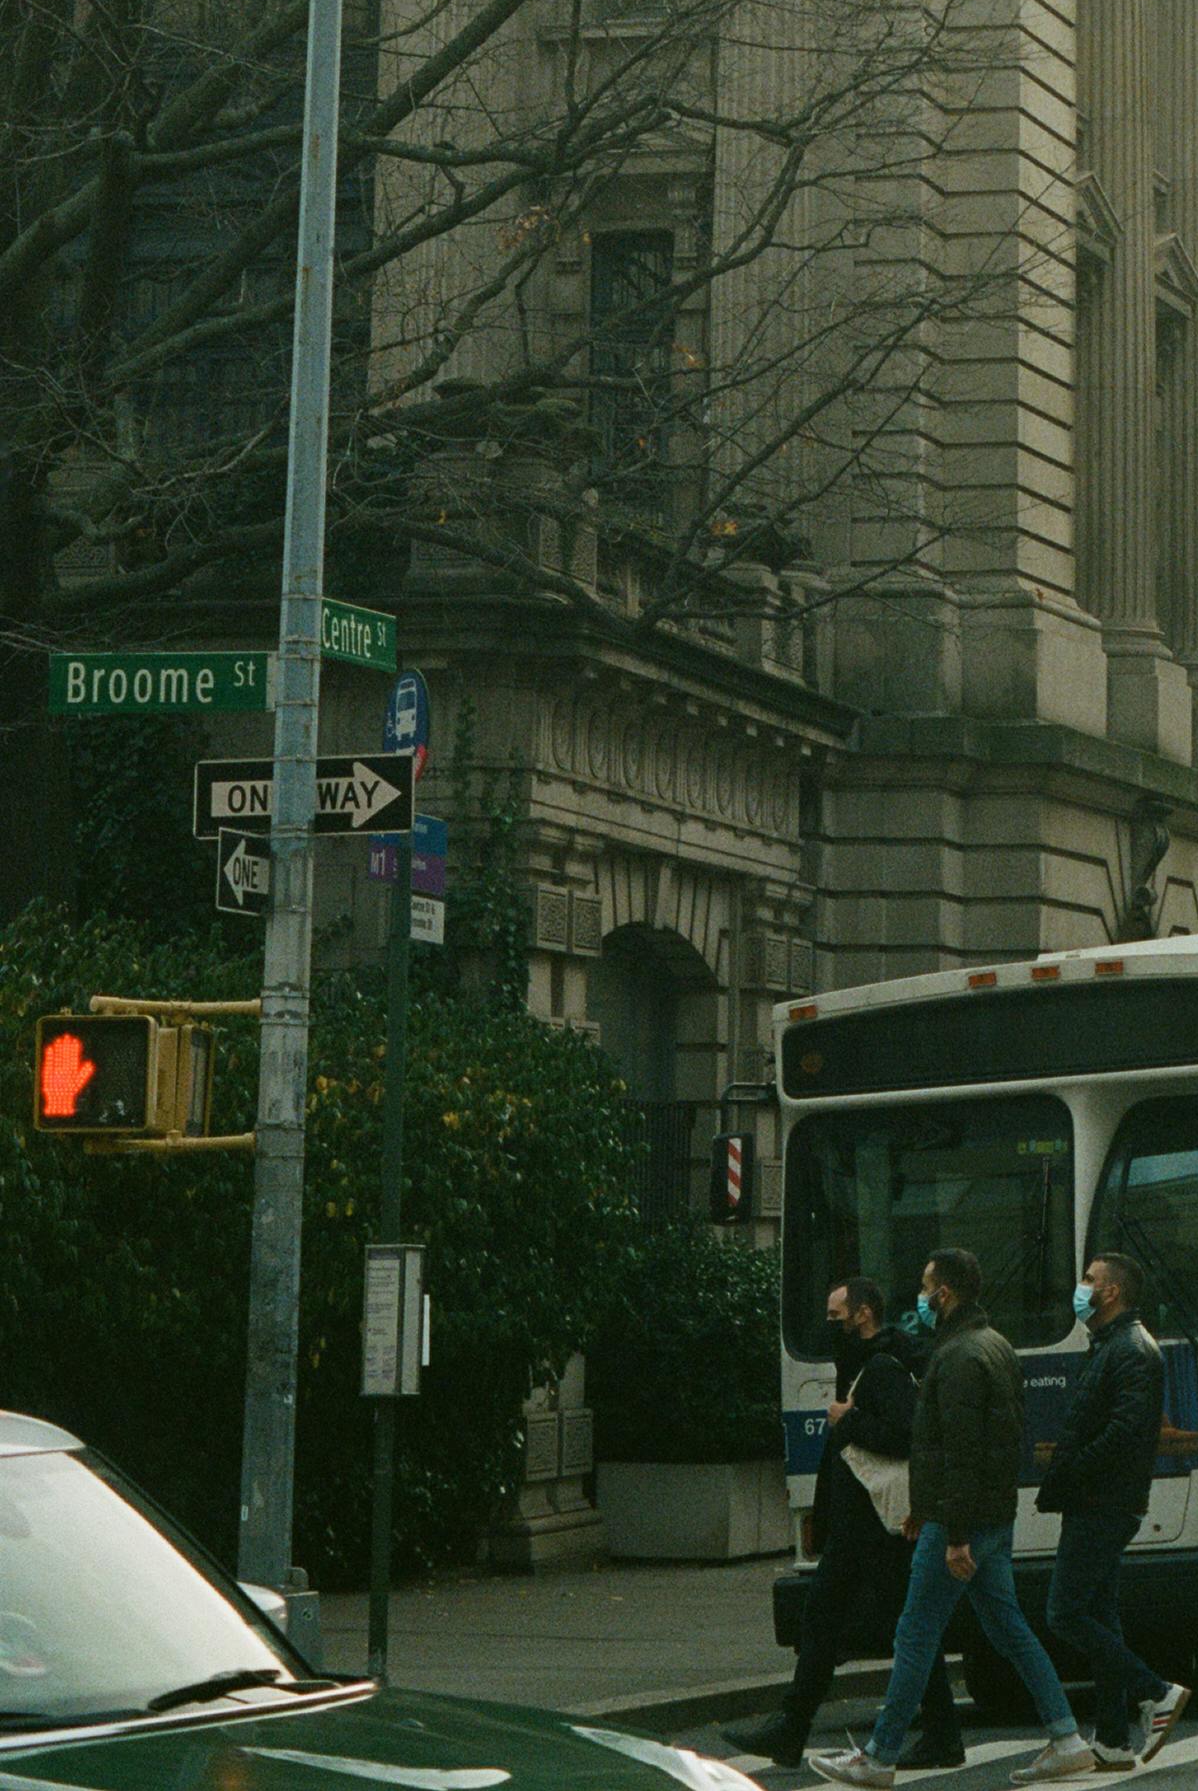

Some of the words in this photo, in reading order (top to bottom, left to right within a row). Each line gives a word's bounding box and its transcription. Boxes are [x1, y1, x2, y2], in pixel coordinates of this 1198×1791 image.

[321, 608, 371, 657] Centre
[376, 621, 386, 647] St
[67, 662, 214, 704] Broome
[233, 660, 255, 687] St
[227, 784, 269, 813] ON
[317, 781, 380, 810] WAY
[233, 857, 258, 889] ONE
[1030, 1375, 1067, 1389] eating
[804, 1418, 826, 1436] 67
